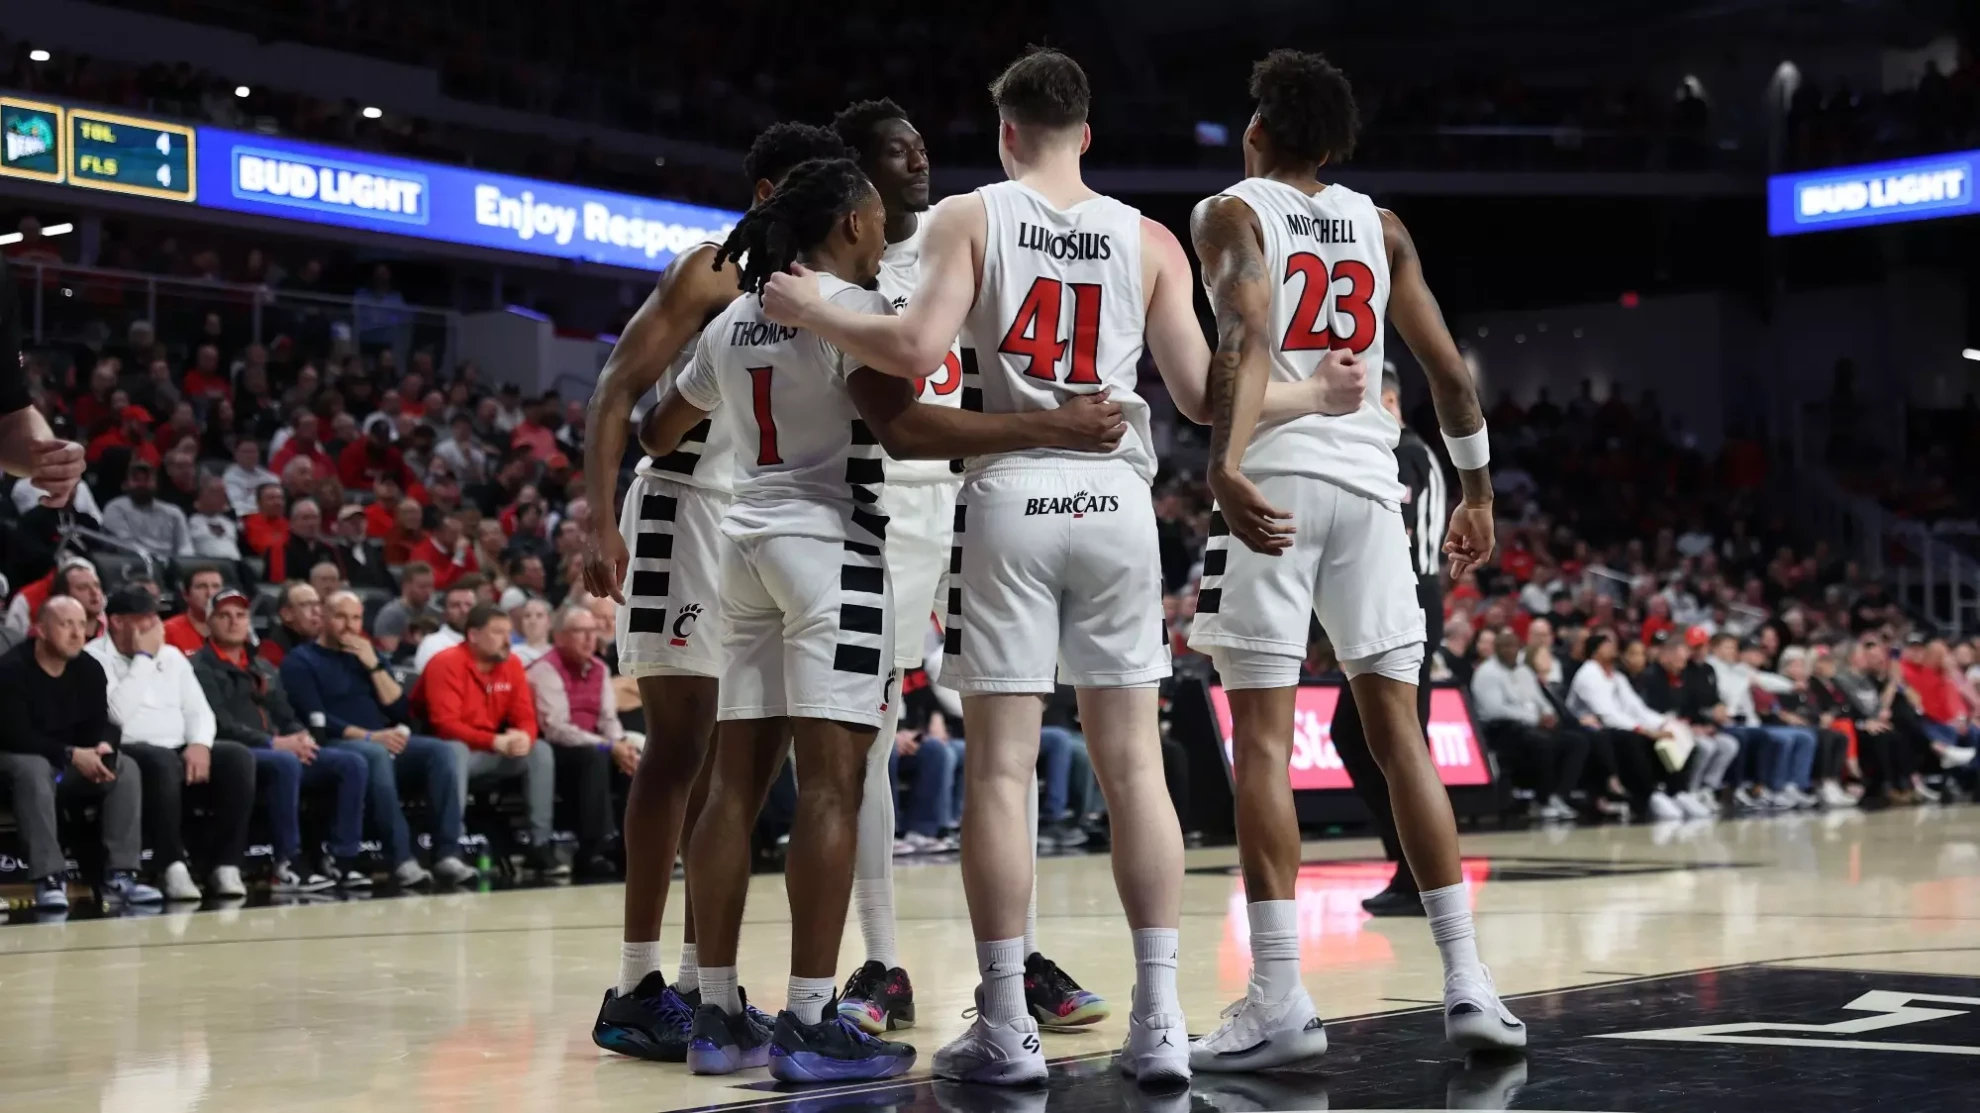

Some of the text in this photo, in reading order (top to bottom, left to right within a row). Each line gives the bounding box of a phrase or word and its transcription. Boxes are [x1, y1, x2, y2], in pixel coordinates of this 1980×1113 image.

[239, 155, 422, 214] BUD LIGHT
[1801, 169, 1965, 216] BUD LIGHT
[475, 184, 577, 245] Enjoy
[1018, 222, 1111, 260] LUKOŠIUS
[1286, 214, 1356, 243] MITCHELL
[998, 276, 1103, 385] 41
[1280, 251, 1377, 355] 23
[746, 366, 784, 466] 1
[1024, 494, 1119, 517] BEARCATS
